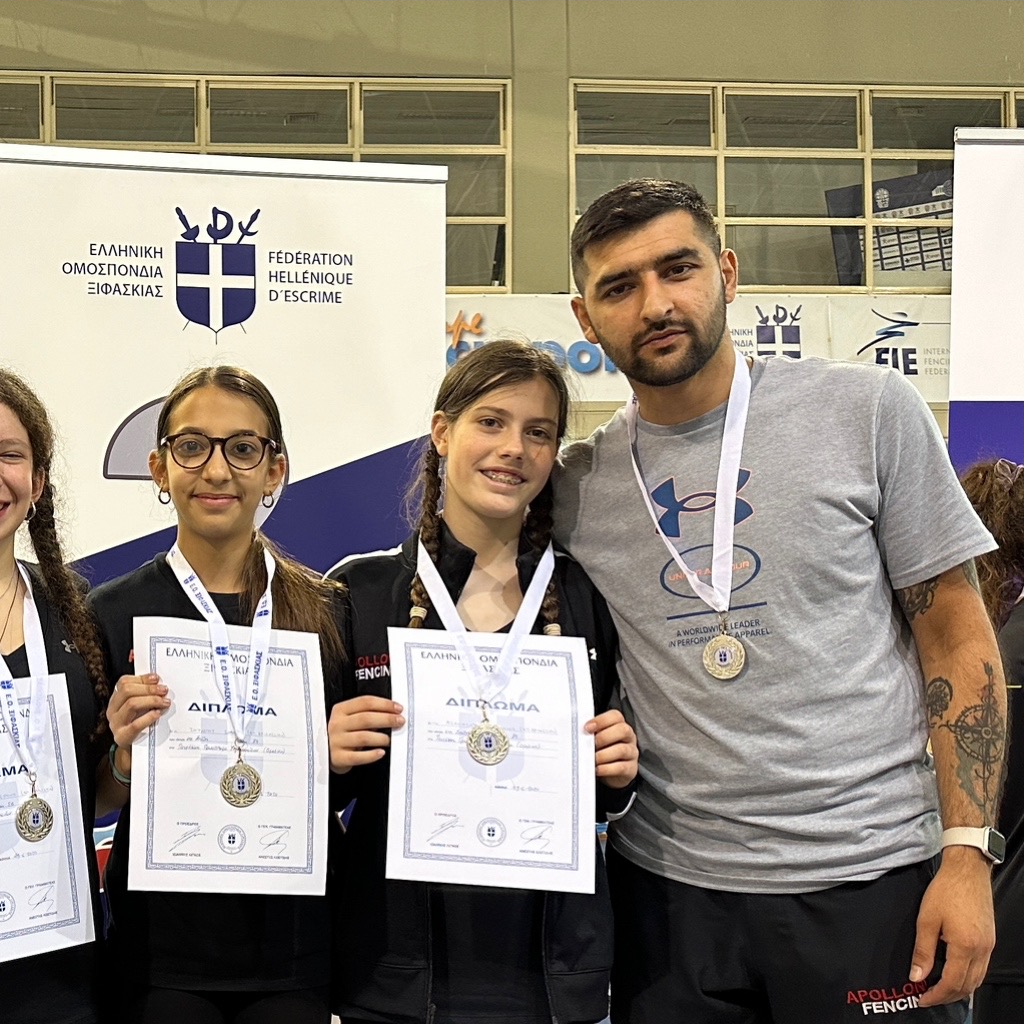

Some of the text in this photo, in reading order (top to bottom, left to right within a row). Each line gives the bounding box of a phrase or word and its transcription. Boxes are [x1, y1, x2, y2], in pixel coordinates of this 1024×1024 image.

[89, 243, 164, 259] ΕΛΛΗΝΙΚΗ
[268, 250, 354, 266] FÉDÉRATION
[62, 262, 164, 278] ΟΜΟΣΠΟΝΔΙΑ
[268, 270, 354, 286] HELLÉNIQUE
[87, 281, 164, 298] ΞΙΦΑΣΚΙΑΣ
[730, 619, 761, 629] LEADER
[445, 698, 541, 713] ΔΙΠΛΩΜΑ
[846, 980, 927, 1004] APOLLON
[861, 994, 923, 1016] FENCIN
